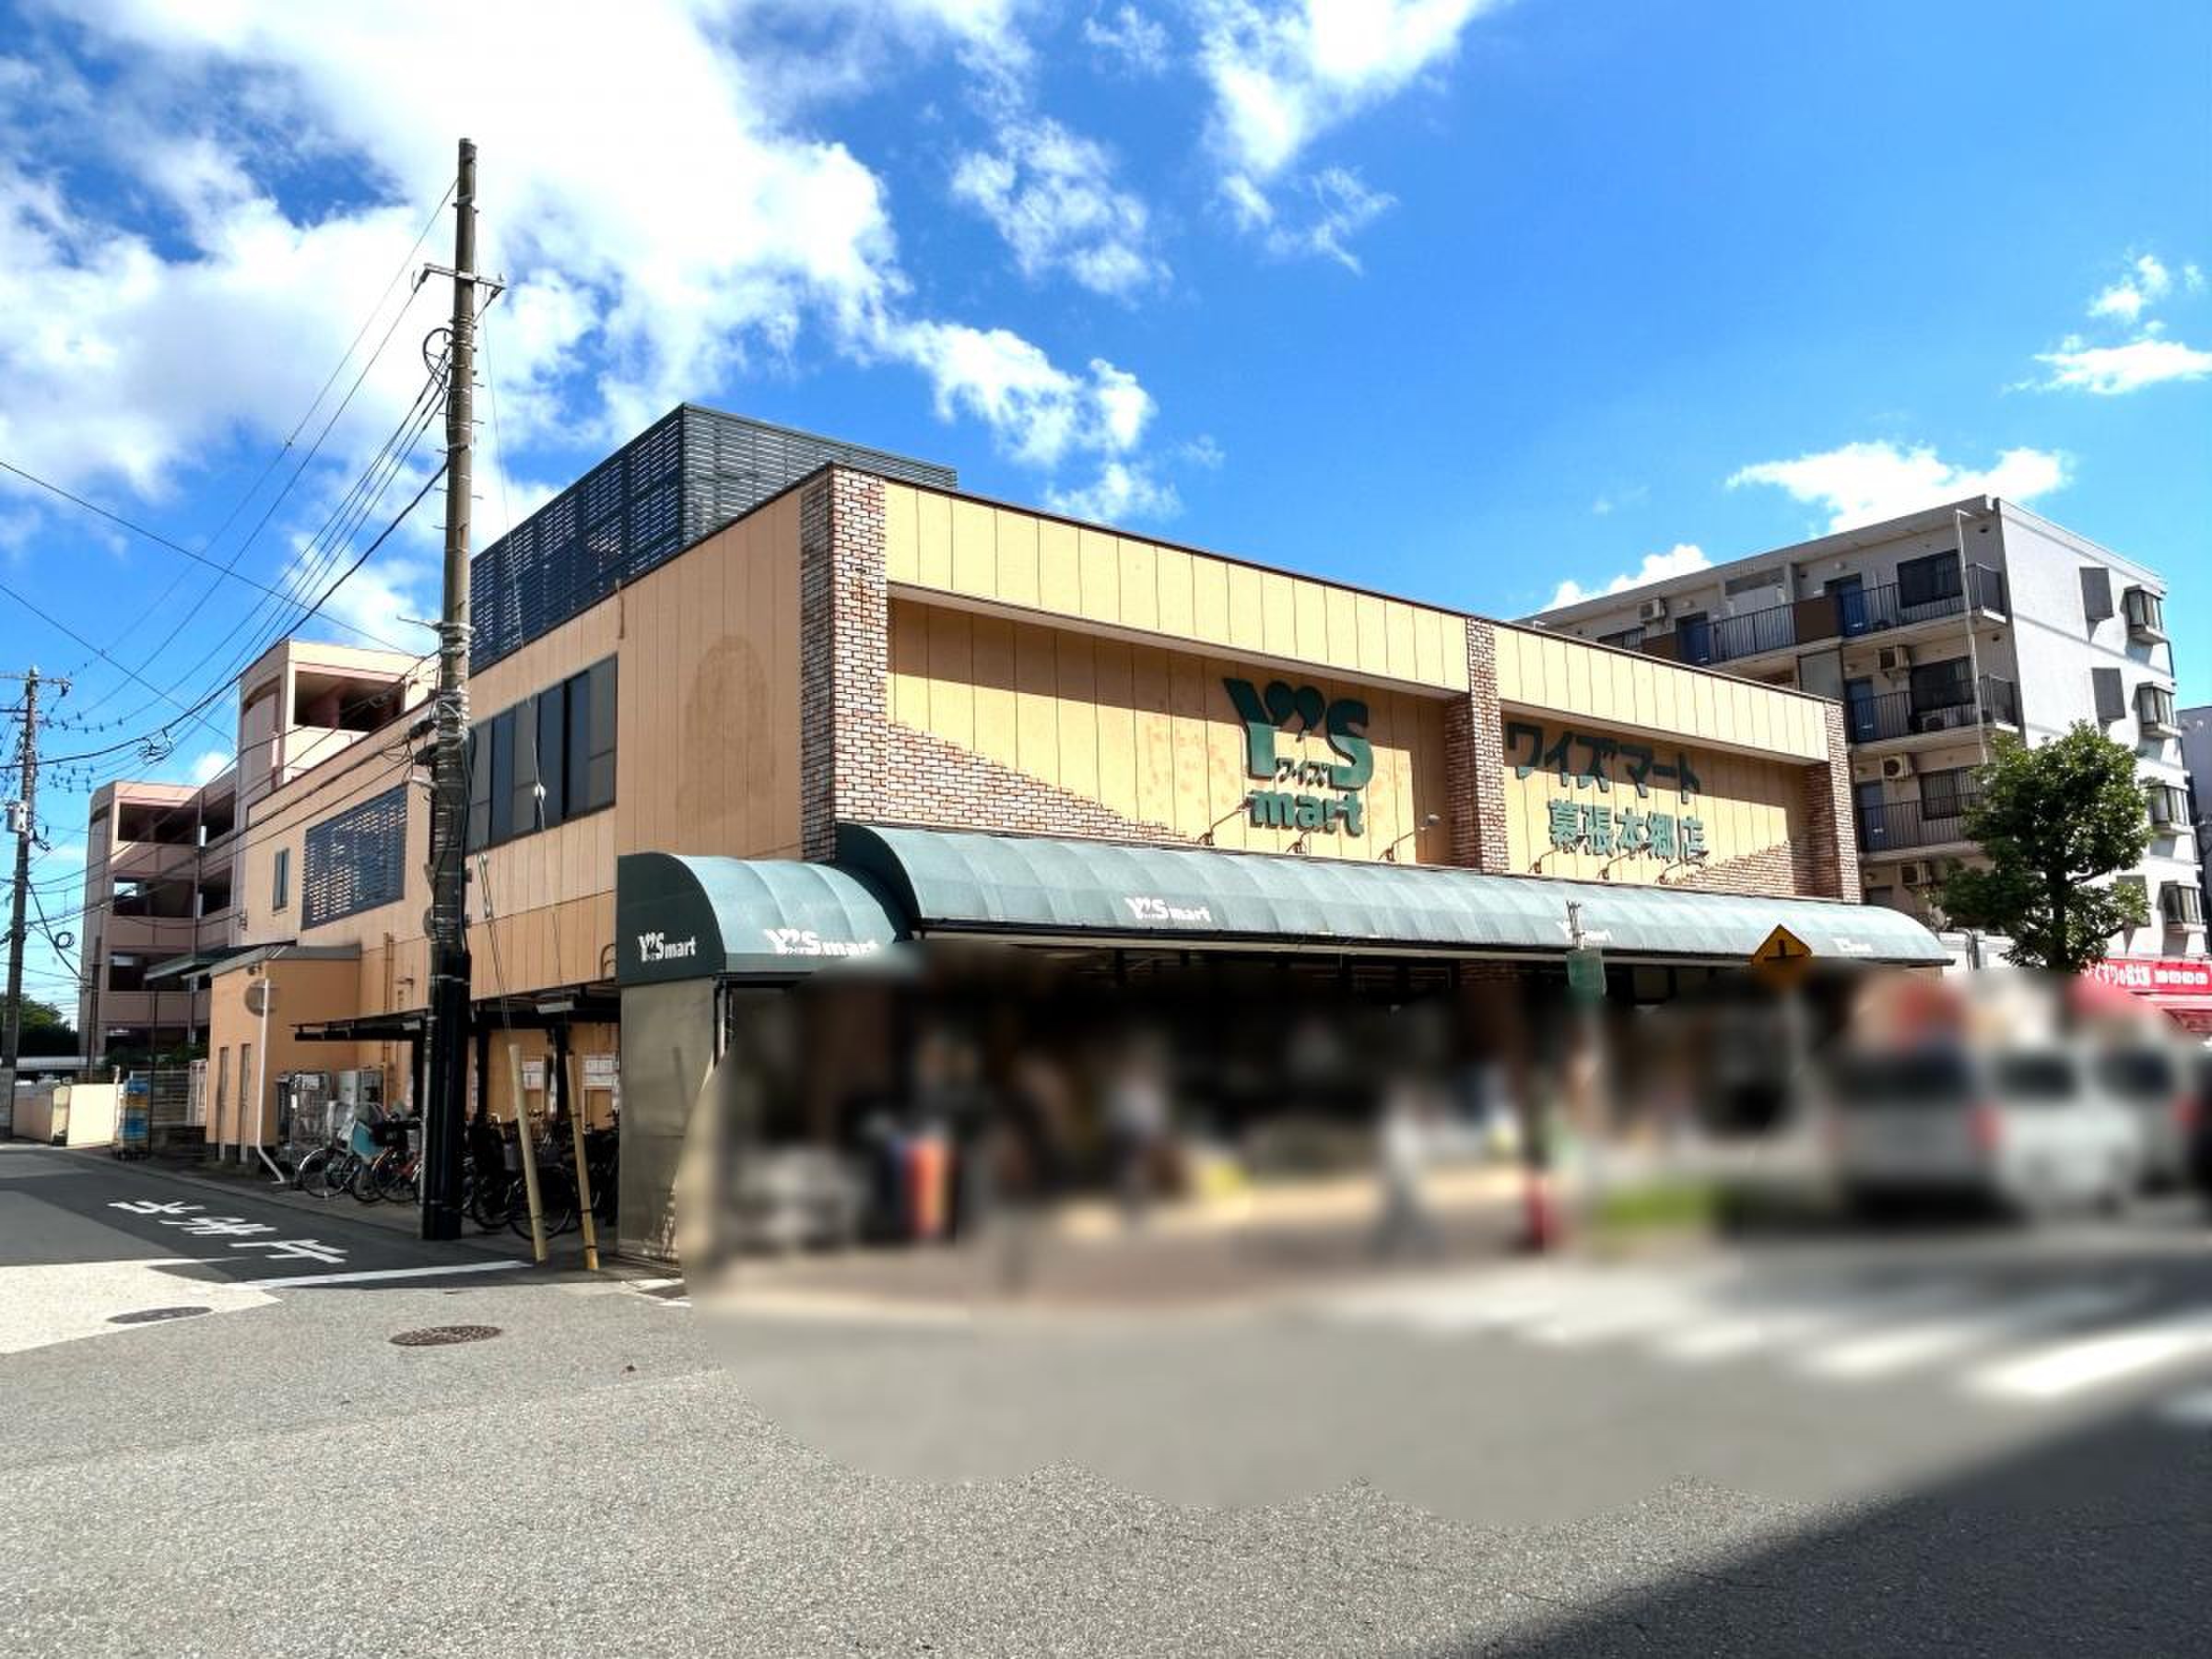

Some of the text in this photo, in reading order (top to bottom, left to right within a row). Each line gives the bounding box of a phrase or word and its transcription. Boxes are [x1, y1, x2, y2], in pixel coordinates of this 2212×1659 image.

[1276, 757, 1328, 788] ワイズ
[1507, 724, 1700, 805] ワイズマート
[1249, 789, 1364, 837] mart
[1548, 798, 1705, 865] 幕張本郷店
[107, 1200, 349, 1264] 止まれ
